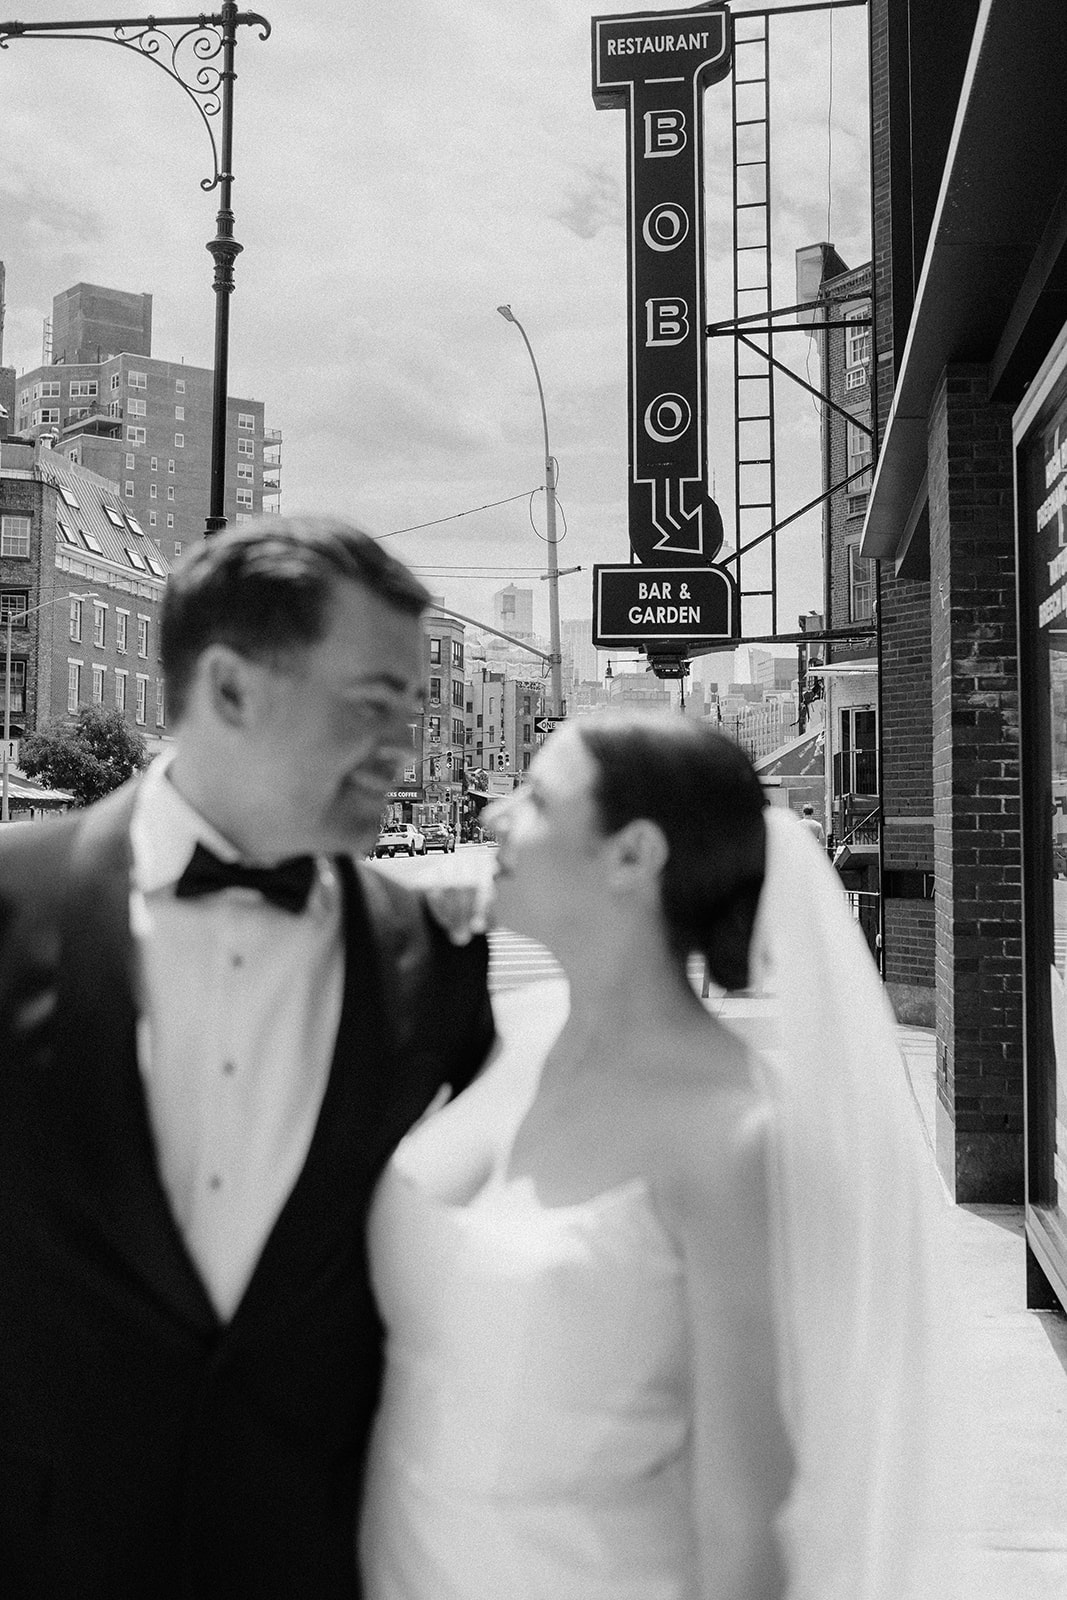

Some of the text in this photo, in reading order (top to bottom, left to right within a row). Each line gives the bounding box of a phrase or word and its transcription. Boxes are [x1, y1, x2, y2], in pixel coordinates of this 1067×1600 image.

[607, 32, 709, 56] RESTAURANT
[643, 109, 691, 443] BOBO
[638, 582, 692, 600] BAR &
[628, 606, 701, 624] GARDEN
[541, 721, 556, 729] ONE
